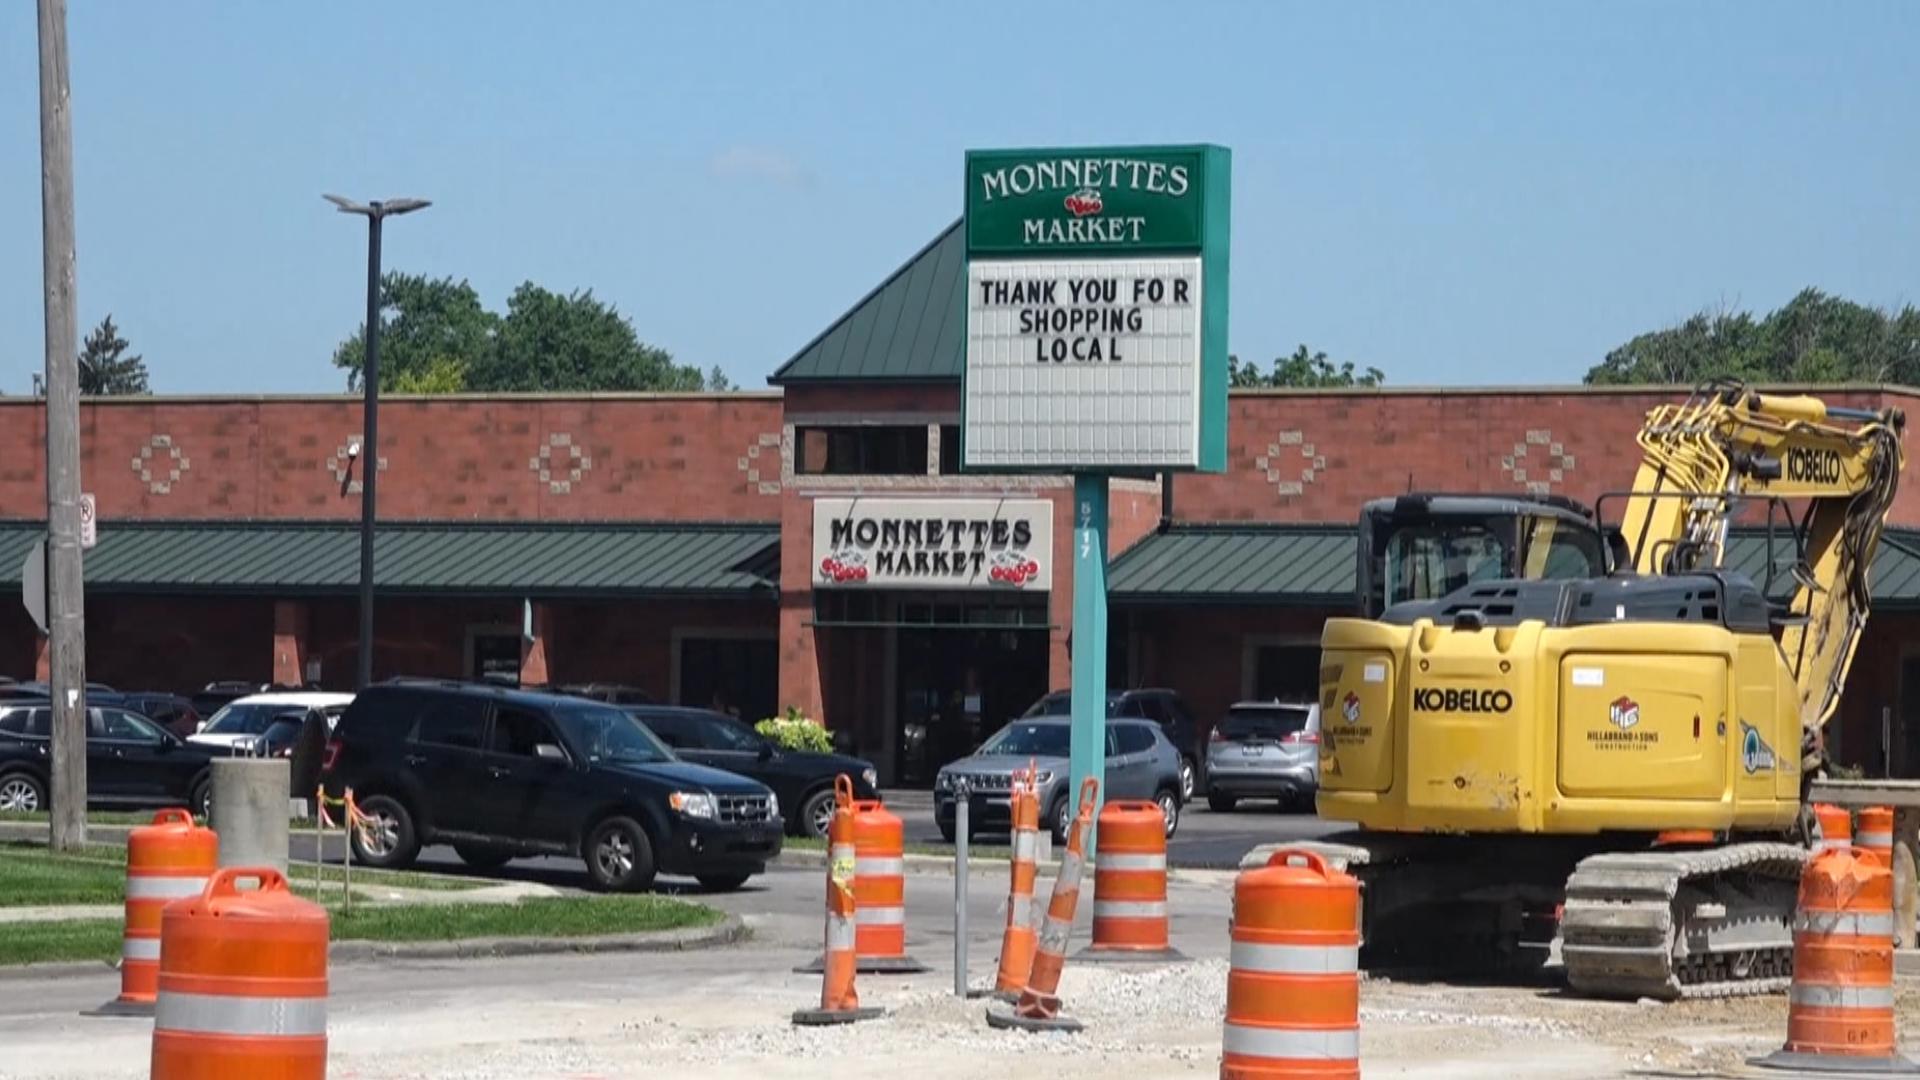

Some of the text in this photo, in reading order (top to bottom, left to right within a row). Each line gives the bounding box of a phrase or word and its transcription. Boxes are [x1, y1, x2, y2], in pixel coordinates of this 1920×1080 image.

[982, 158, 1189, 200] MONNETTES
[1023, 216, 1146, 244] MARKET
[981, 278, 1189, 305] THANK YOU FOR
[1020, 307, 1143, 334] SHOPPING
[1036, 336, 1122, 362] LOCAL
[1787, 447, 1840, 485] KOBELCO
[831, 518, 1032, 549] MONNETTES
[875, 550, 985, 576] MARKET
[1413, 689, 1513, 713] KOBELCO
